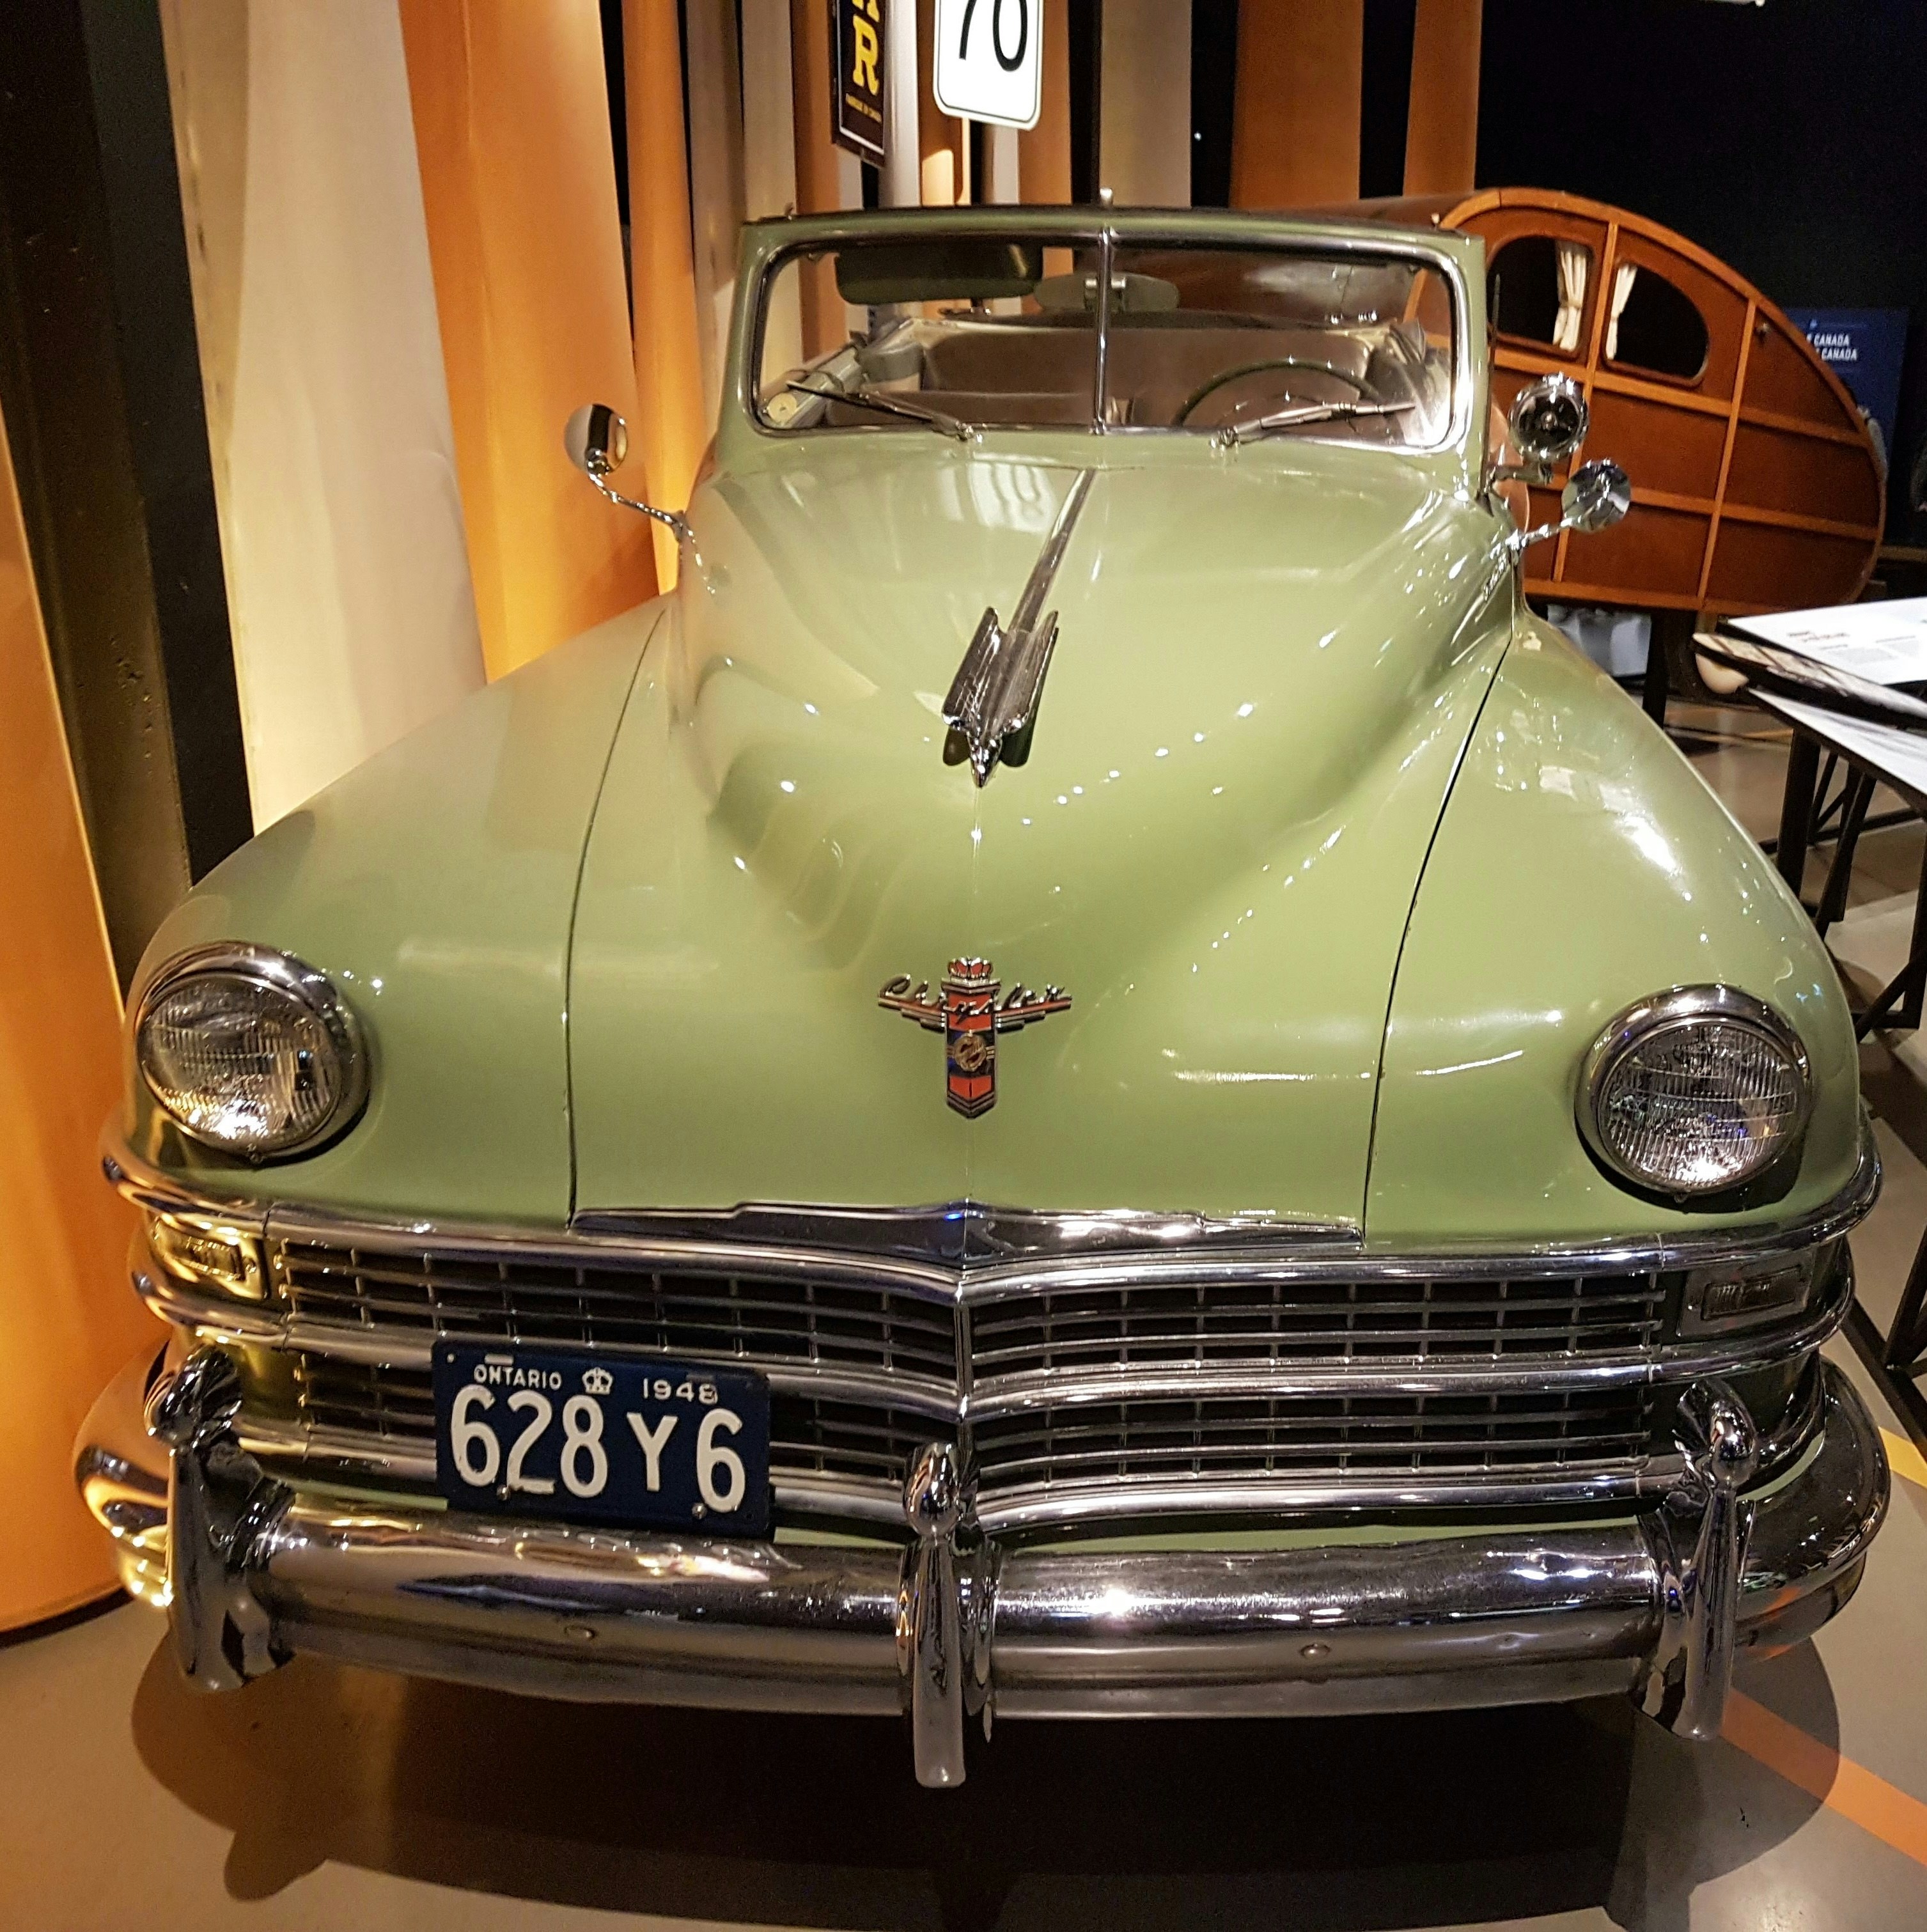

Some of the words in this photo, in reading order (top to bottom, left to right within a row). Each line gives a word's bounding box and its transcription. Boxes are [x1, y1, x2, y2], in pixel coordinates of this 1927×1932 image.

[1814, 334, 1849, 347] CANADA
[1822, 348, 1857, 361] CANADA
[474, 1364, 562, 1391] ONTARIO
[643, 1378, 720, 1405] 1948
